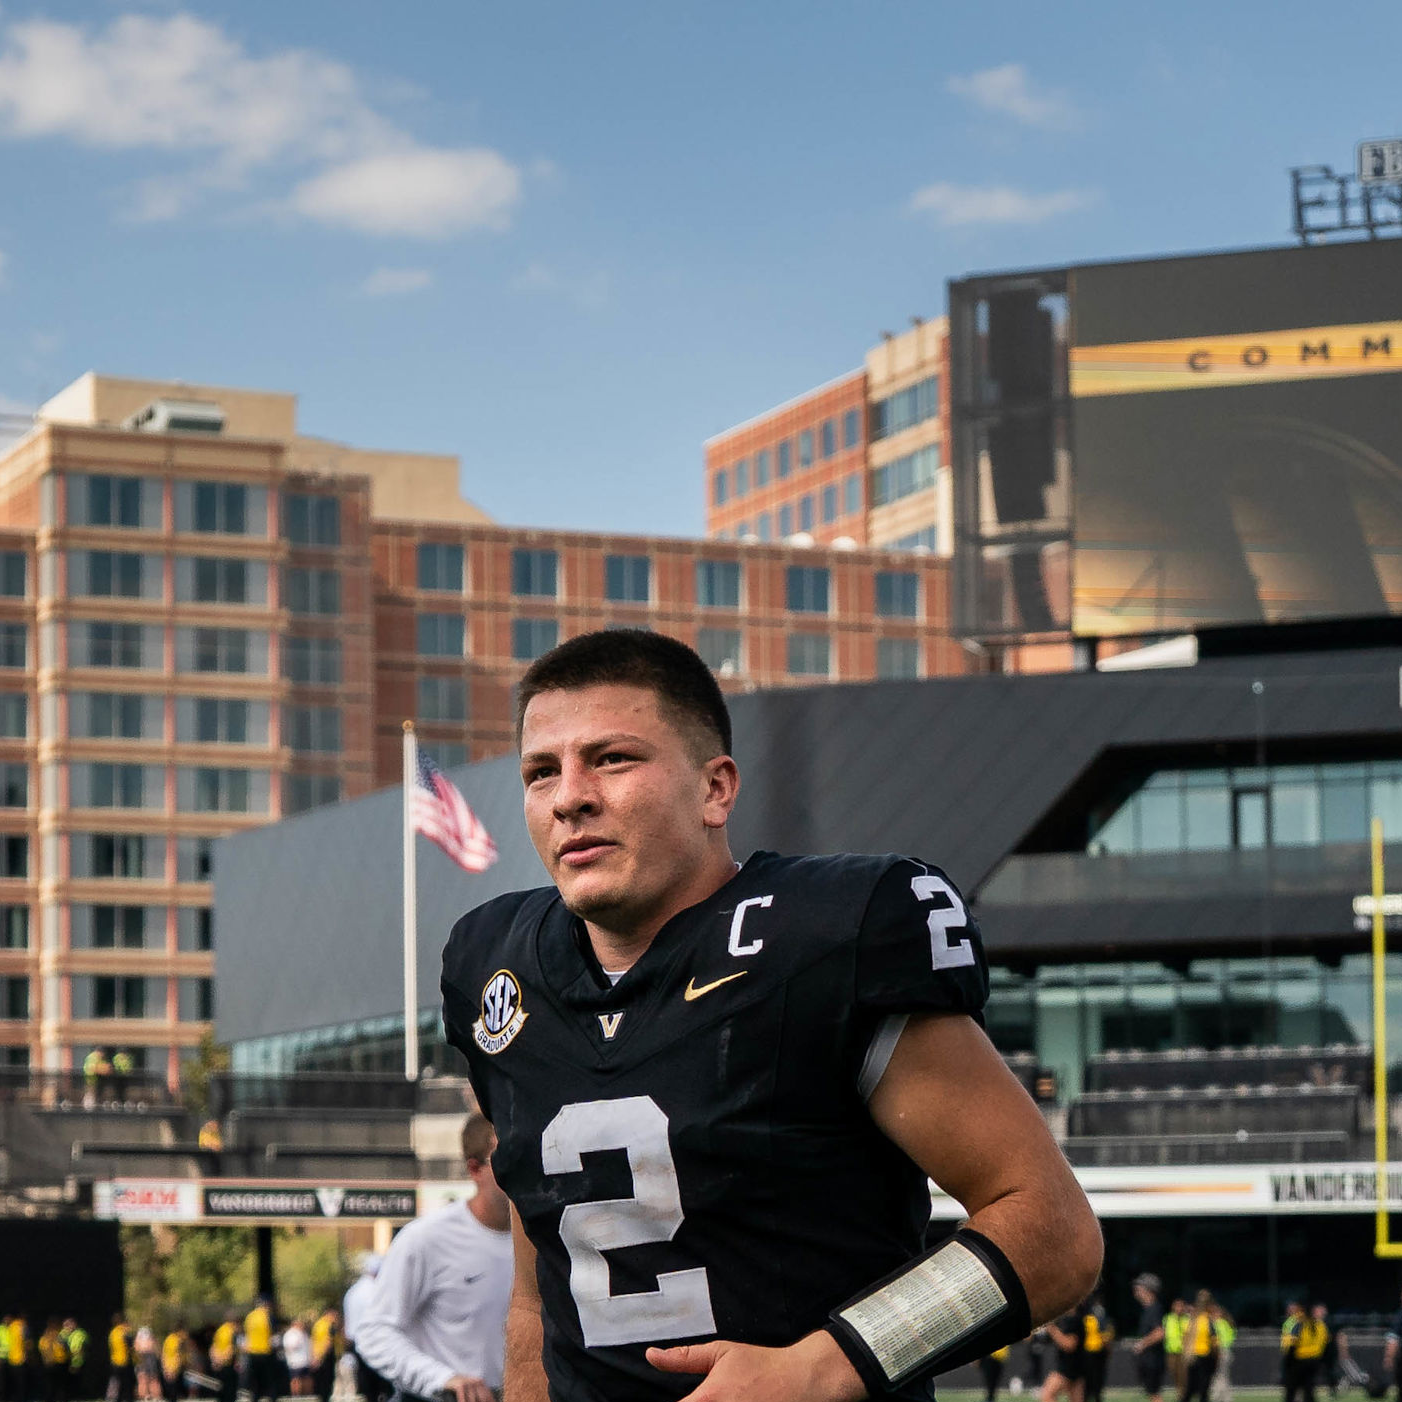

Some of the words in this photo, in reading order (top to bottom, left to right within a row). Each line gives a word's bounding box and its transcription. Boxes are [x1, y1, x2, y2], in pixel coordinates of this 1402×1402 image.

[728, 895, 774, 957] C
[909, 874, 976, 970] 2
[484, 974, 517, 1032] SEC
[597, 1011, 626, 1041] V
[476, 1026, 517, 1052] GRADUATE
[541, 1095, 717, 1348] 2
